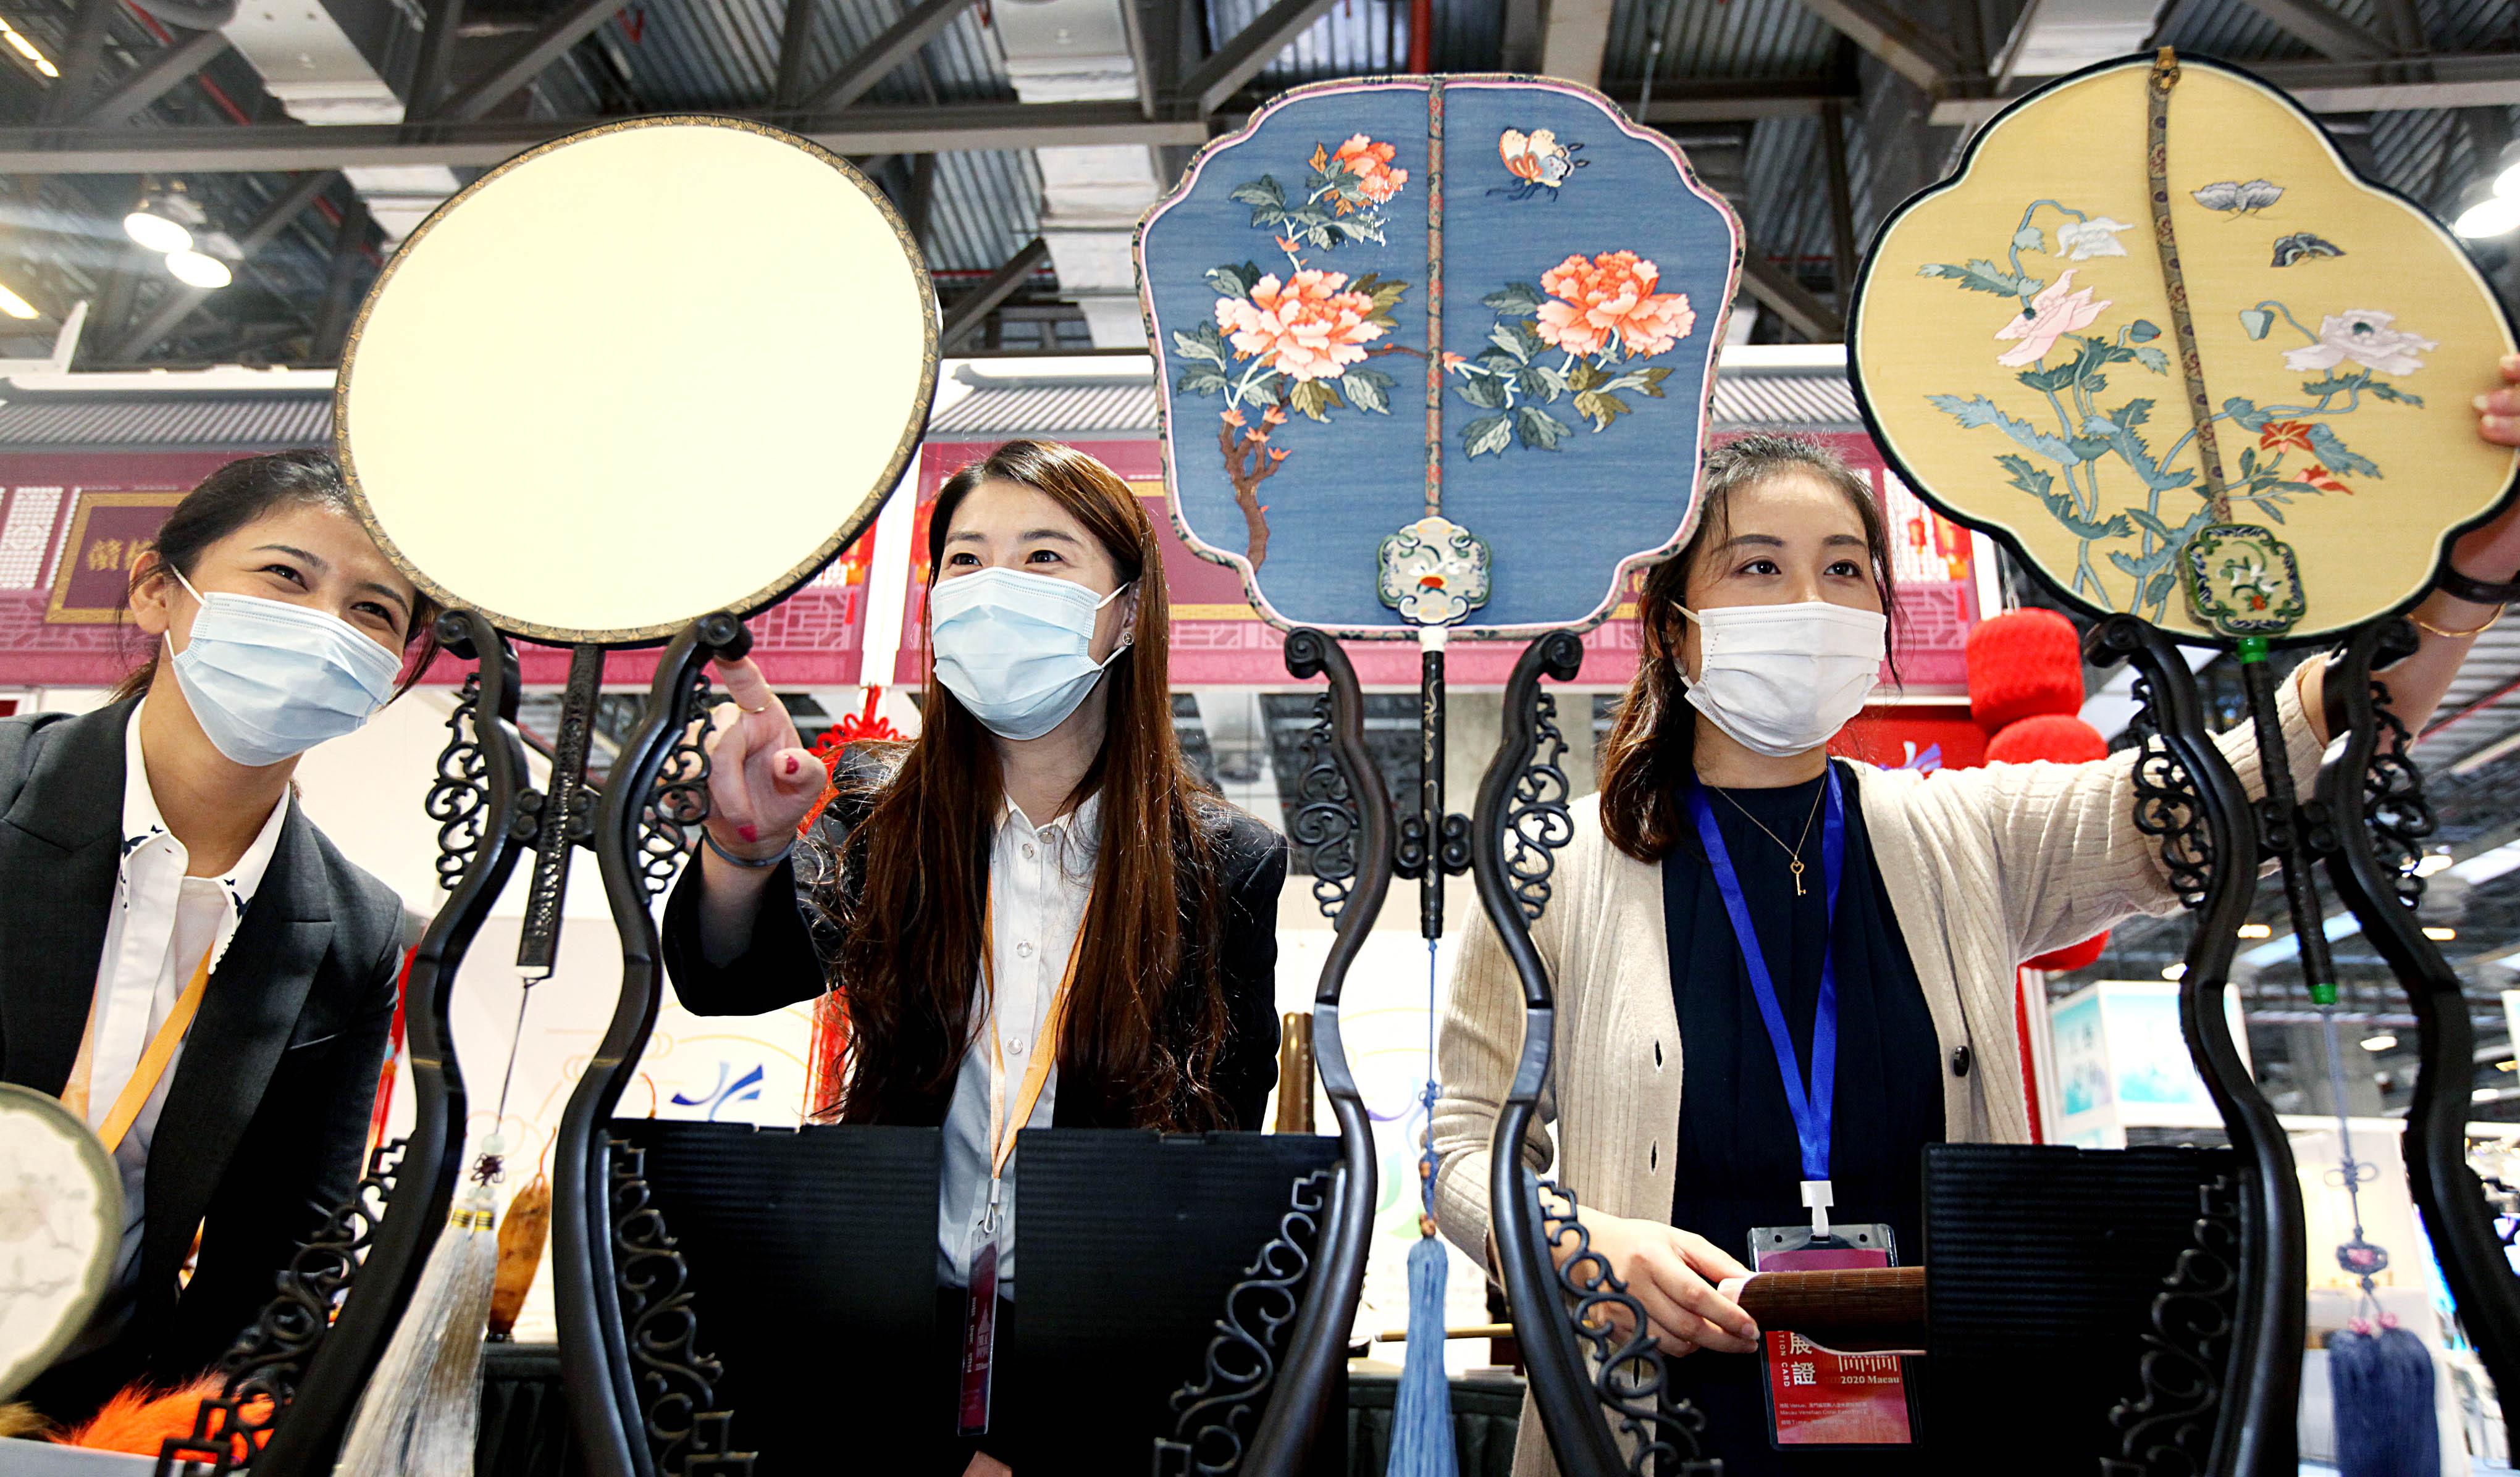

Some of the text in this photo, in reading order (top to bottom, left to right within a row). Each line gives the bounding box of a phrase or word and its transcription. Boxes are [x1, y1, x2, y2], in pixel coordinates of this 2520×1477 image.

[1781, 1362, 1790, 1387] CARD
[1840, 1375, 1900, 1384] 2020 Macau
